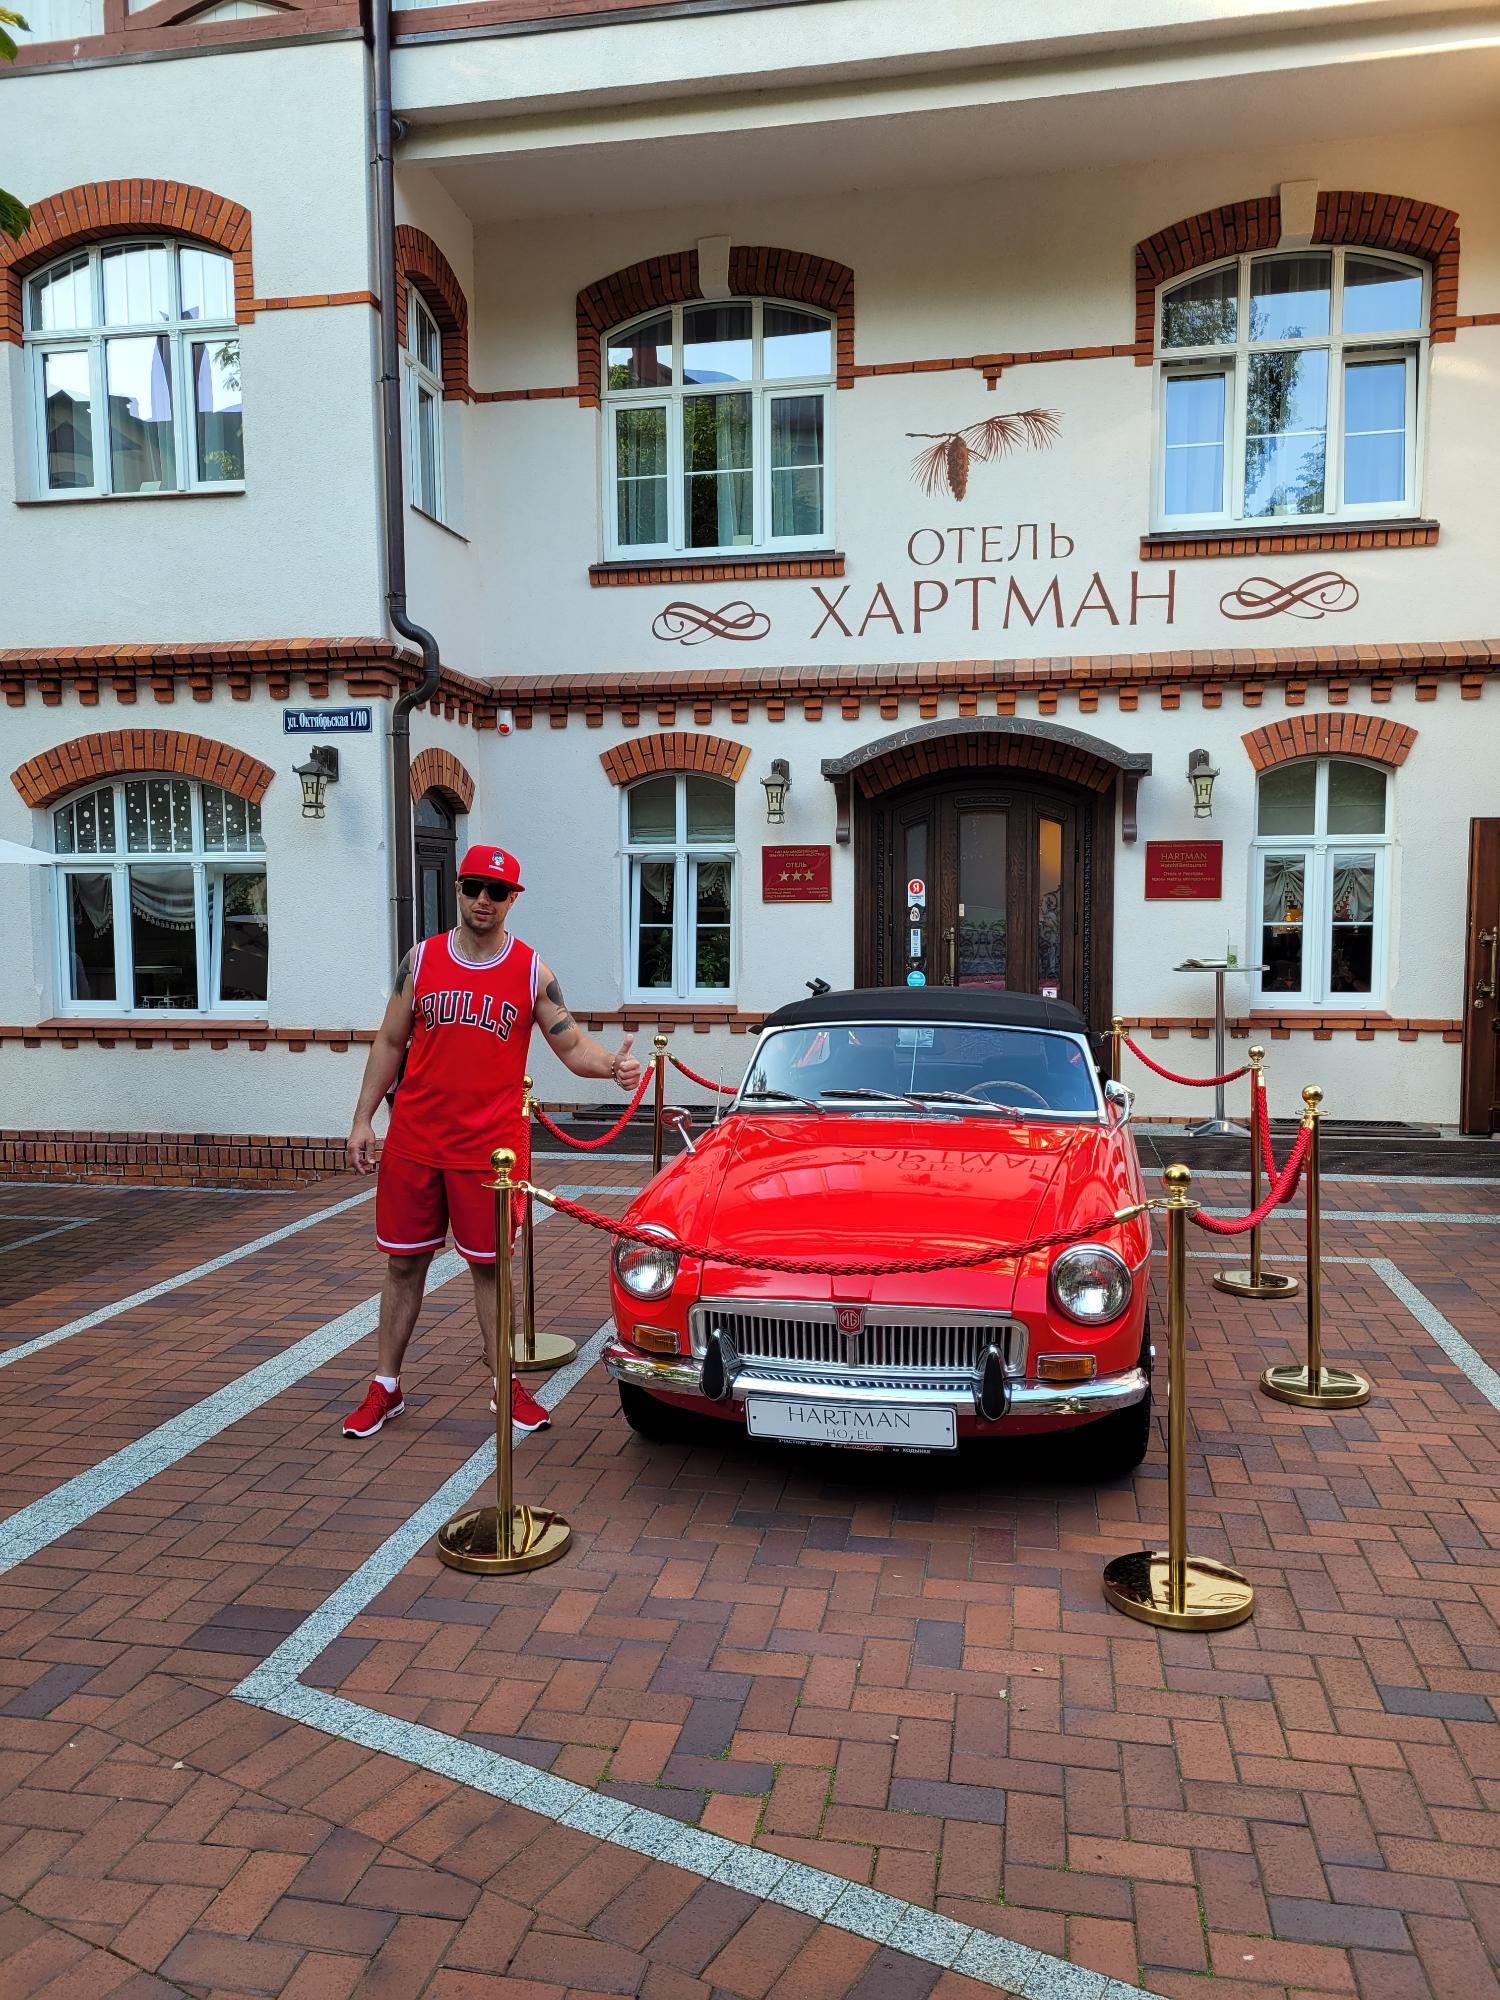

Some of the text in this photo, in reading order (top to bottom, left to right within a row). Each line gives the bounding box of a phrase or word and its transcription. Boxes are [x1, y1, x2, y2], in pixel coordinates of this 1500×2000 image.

[907, 522, 1075, 566] ОТЕЛЬ
[810, 569, 1176, 639] ХАРТМАН
[287, 710, 368, 730] ул. Октябрьская 1/10
[1161, 852, 1208, 861] HARTMAN
[420, 990, 519, 1042] BULLS
[841, 1311, 859, 1327] MG
[788, 1406, 911, 1429] HARTMAN
[826, 1428, 873, 1440] HOEL
